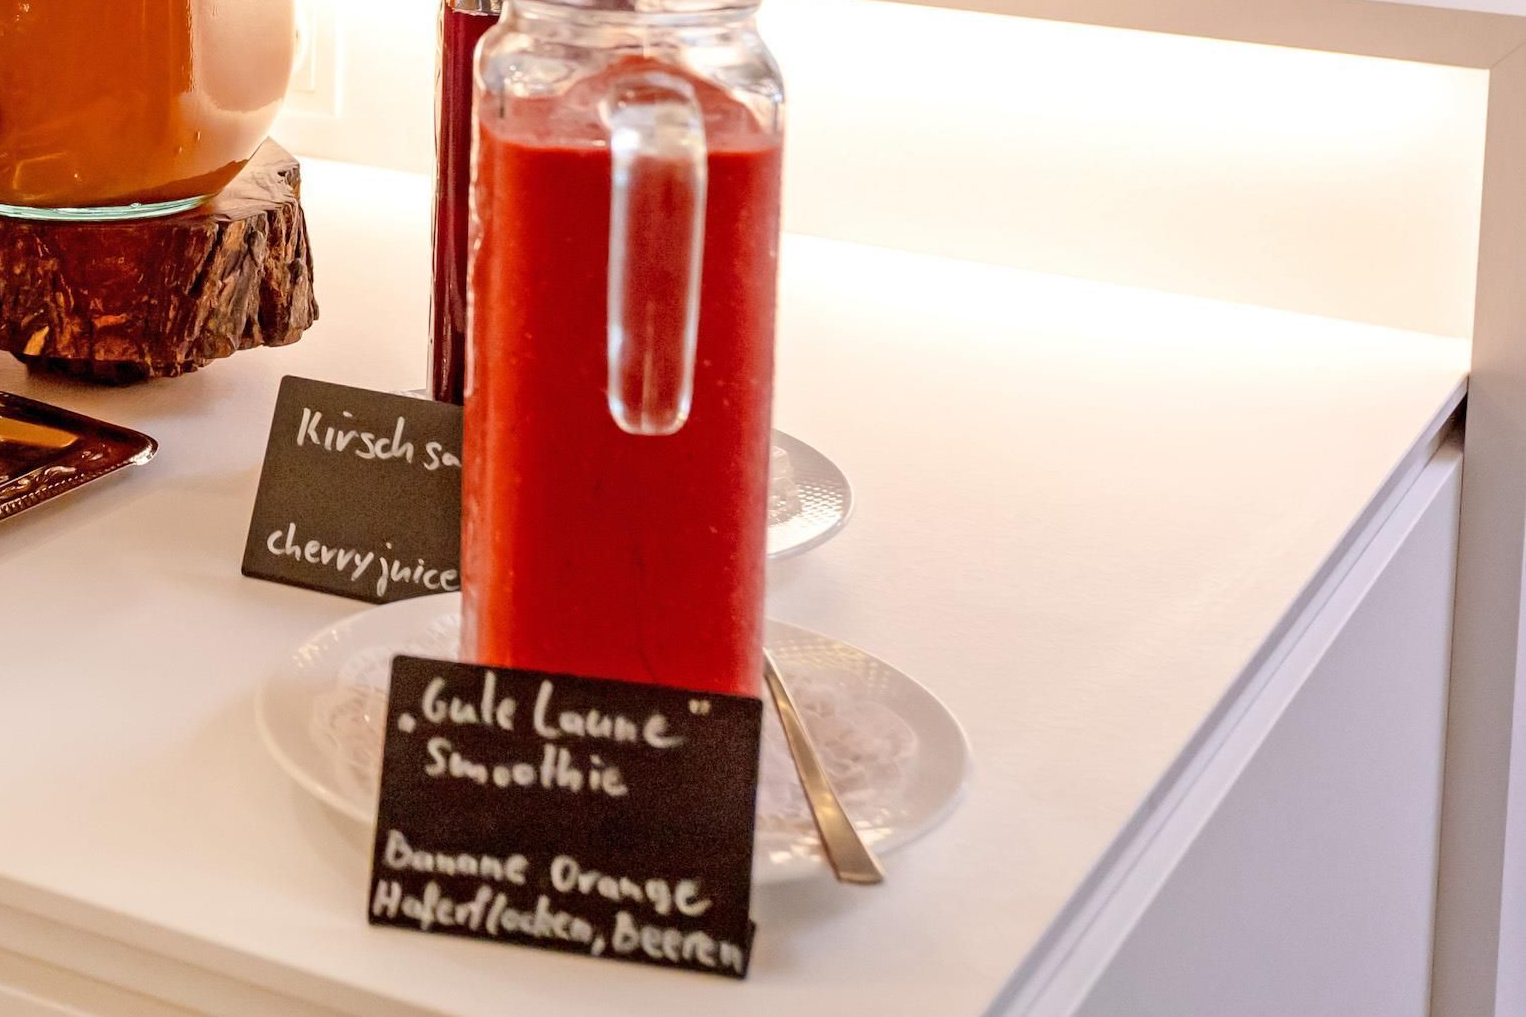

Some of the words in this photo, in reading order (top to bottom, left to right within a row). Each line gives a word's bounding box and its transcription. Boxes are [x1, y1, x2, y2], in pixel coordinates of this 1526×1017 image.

[423, 441, 462, 471] sa
[266, 522, 374, 582] cherry
[376, 542, 460, 598] juice
[425, 736, 629, 797] Smoothie
[550, 854, 713, 917] Orange
